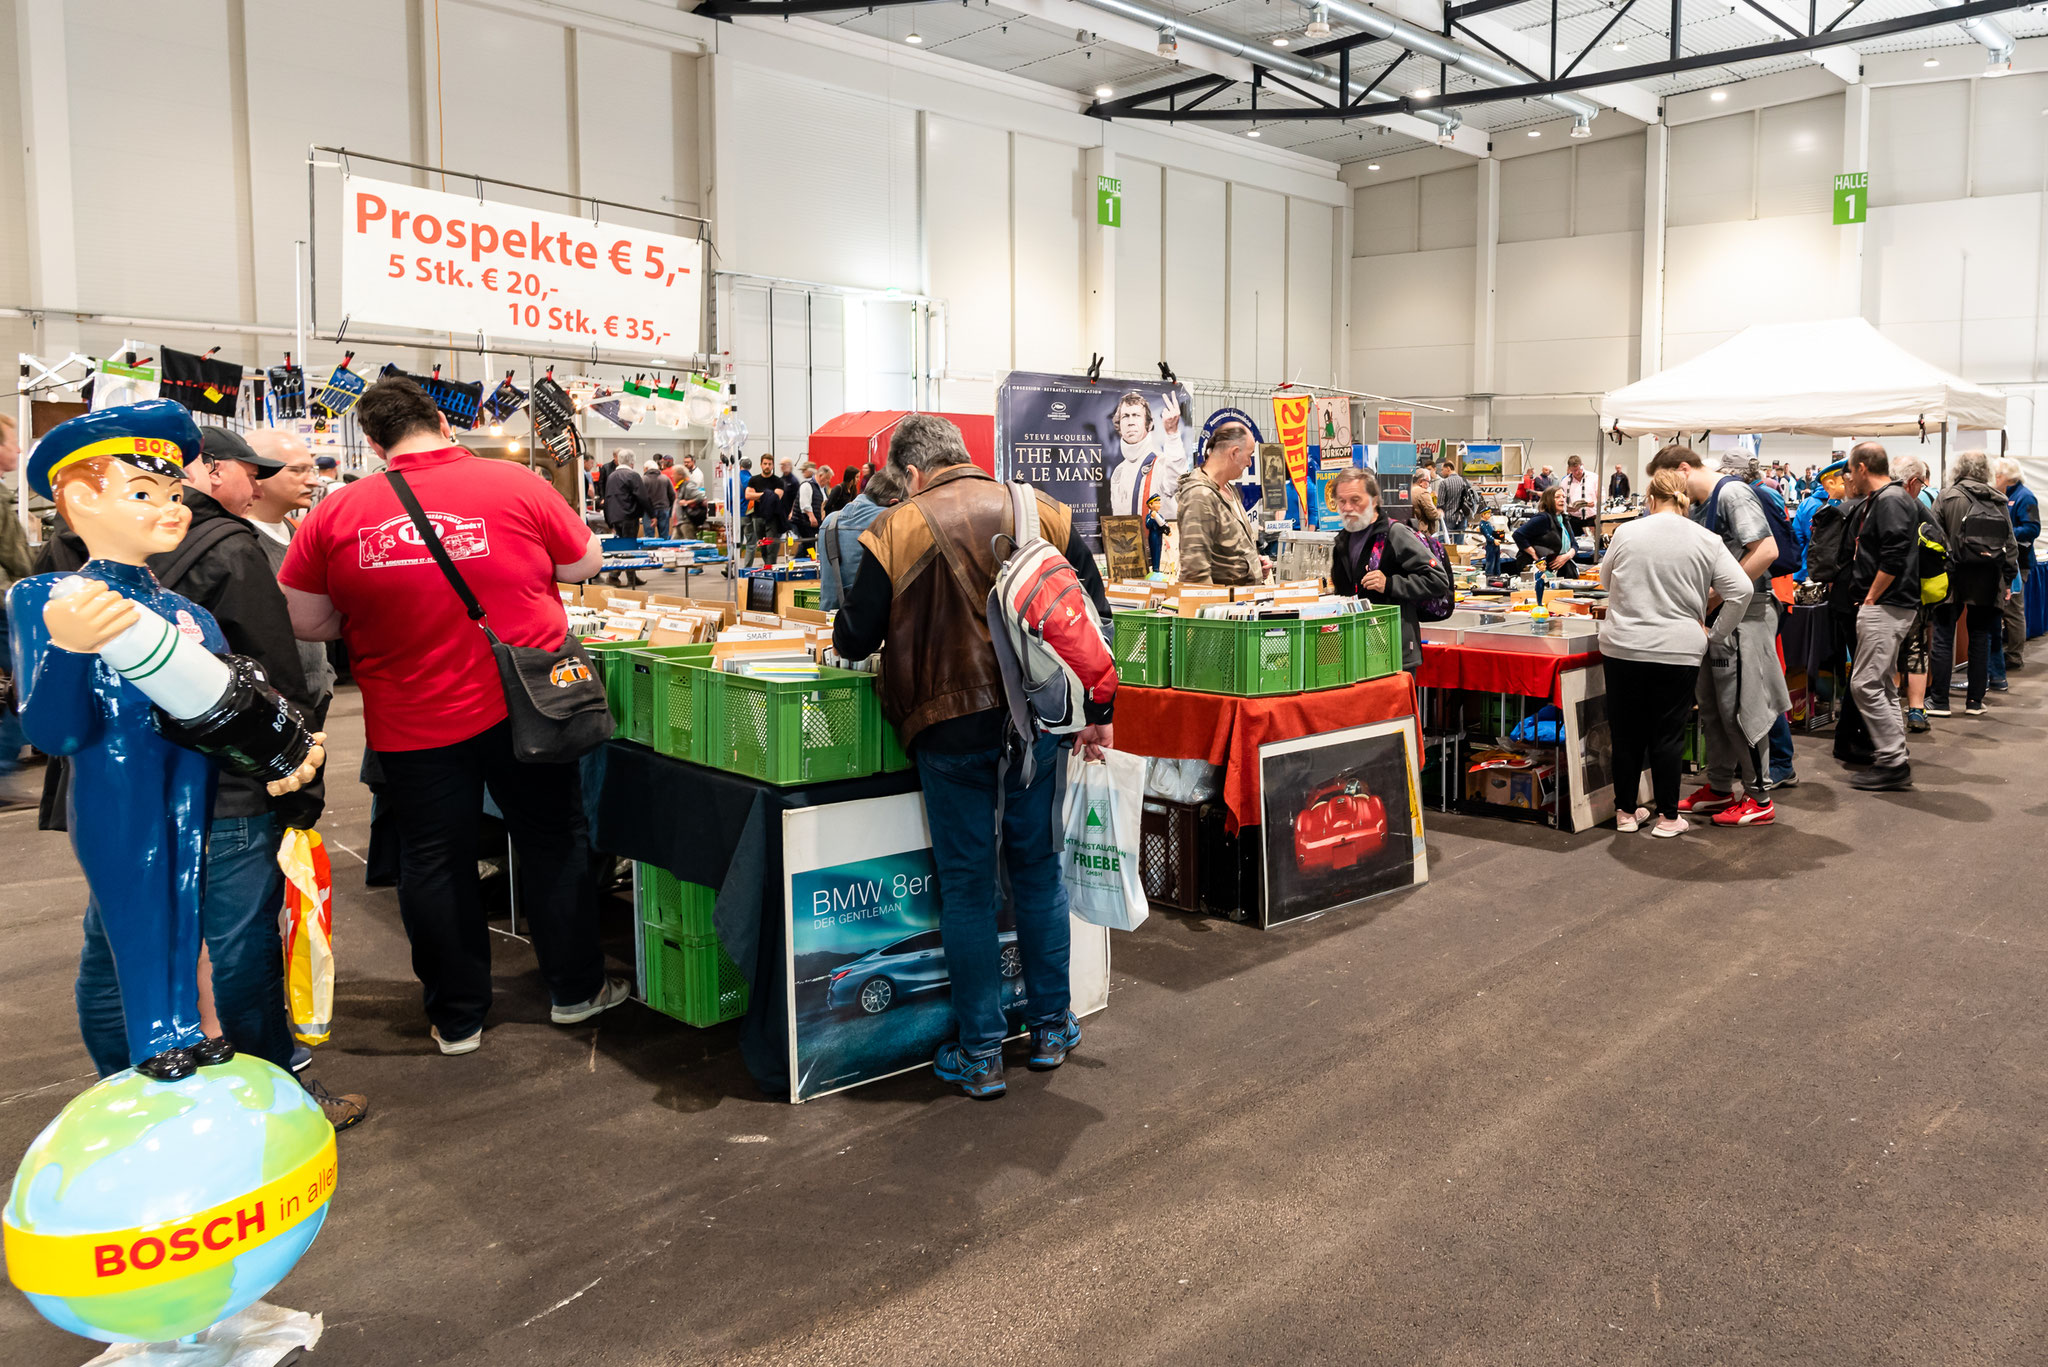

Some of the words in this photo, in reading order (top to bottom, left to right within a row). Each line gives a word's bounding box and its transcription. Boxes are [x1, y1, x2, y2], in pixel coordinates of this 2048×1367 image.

[1098, 176, 1121, 194] HALLE
[1835, 174, 1867, 191] HALLE
[1105, 198, 1113, 222] 1
[1845, 194, 1856, 220] 1
[356, 192, 598, 270] Prospekte
[608, 239, 633, 275] €
[644, 245, 691, 287] 5,-
[387, 253, 406, 278] 5
[415, 257, 474, 288] Stk.
[481, 268, 499, 292] €
[507, 271, 559, 301] 20,-
[508, 303, 541, 328] 10
[548, 306, 598, 335] Stk.
[603, 315, 619, 337] €
[626, 317, 671, 346] 35,-
[1024, 433, 1050, 441] STEVE
[1413, 439, 1440, 454] astrol
[1015, 447, 1052, 464] THE
[1058, 448, 1102, 464] MAN
[1015, 469, 1025, 480] &
[1031, 467, 1051, 482] LE
[1055, 467, 1104, 482] MANS
[746, 632, 773, 640] SMART
[812, 877, 884, 917] BMW
[892, 871, 933, 900] 8er
[813, 915, 836, 930] DER
[838, 901, 902, 925] GENTLEMAN
[94, 1200, 266, 1278] BOSCH
[280, 1194, 300, 1222] in
